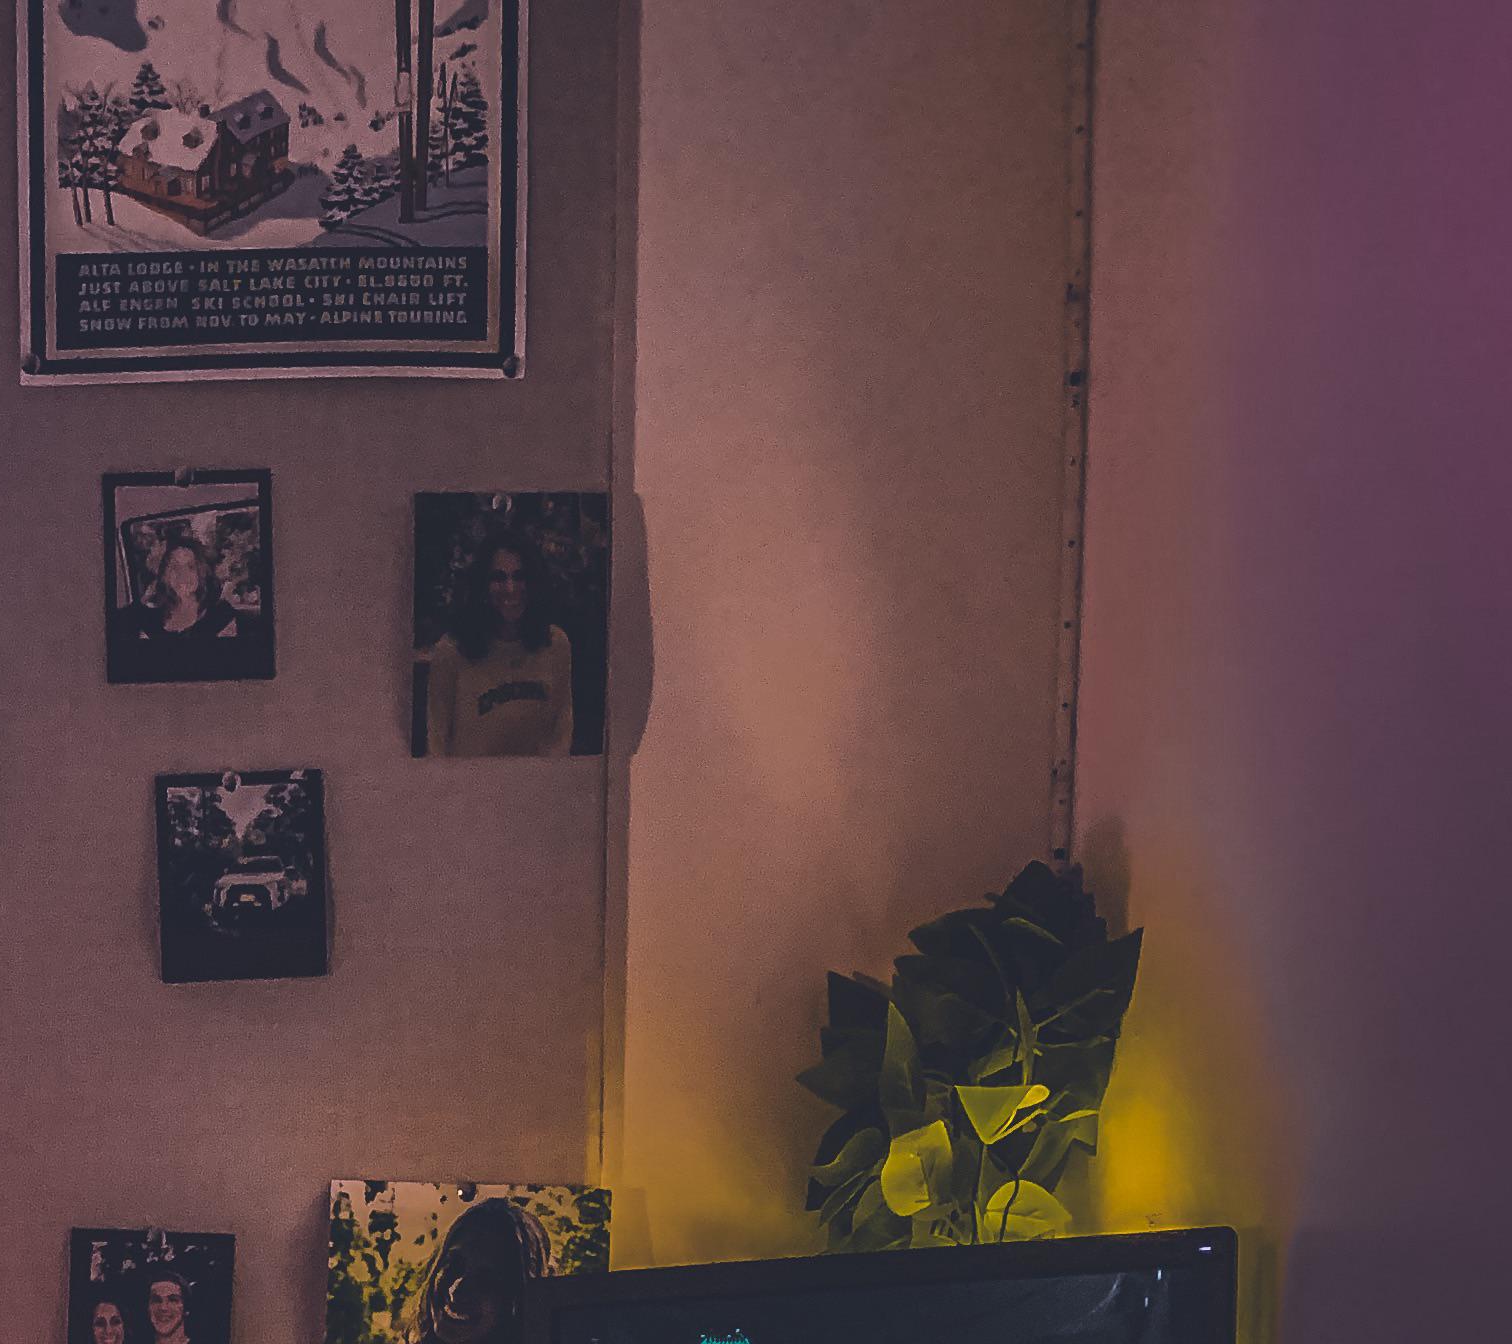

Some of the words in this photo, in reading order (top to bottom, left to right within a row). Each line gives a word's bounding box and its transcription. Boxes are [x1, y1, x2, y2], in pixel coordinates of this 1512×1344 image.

[78, 263, 121, 277] ALTA
[128, 261, 184, 275] LODGE
[200, 260, 219, 273] IN
[227, 259, 260, 273] THE
[267, 257, 351, 272] WASATCH
[359, 256, 467, 270] MOUNTAINS
[78, 281, 121, 296] JUST
[129, 279, 188, 294] ABOVE
[198, 278, 241, 292] SALT
[249, 276, 296, 290] LAKE
[304, 275, 341, 289] CITY
[78, 300, 111, 313] ALF
[191, 297, 223, 310] SKI
[232, 294, 305, 309] SCHOOL
[322, 292, 354, 306] SKI
[362, 292, 420, 305] CHAIR
[429, 292, 467, 305] LIFT
[79, 317, 132, 332] SNOW
[138, 315, 189, 330] FROM
[240, 313, 259, 327] TO
[264, 311, 307, 326] MAY
[319, 310, 383, 325] ALPINE
[388, 310, 467, 324] TOURING
